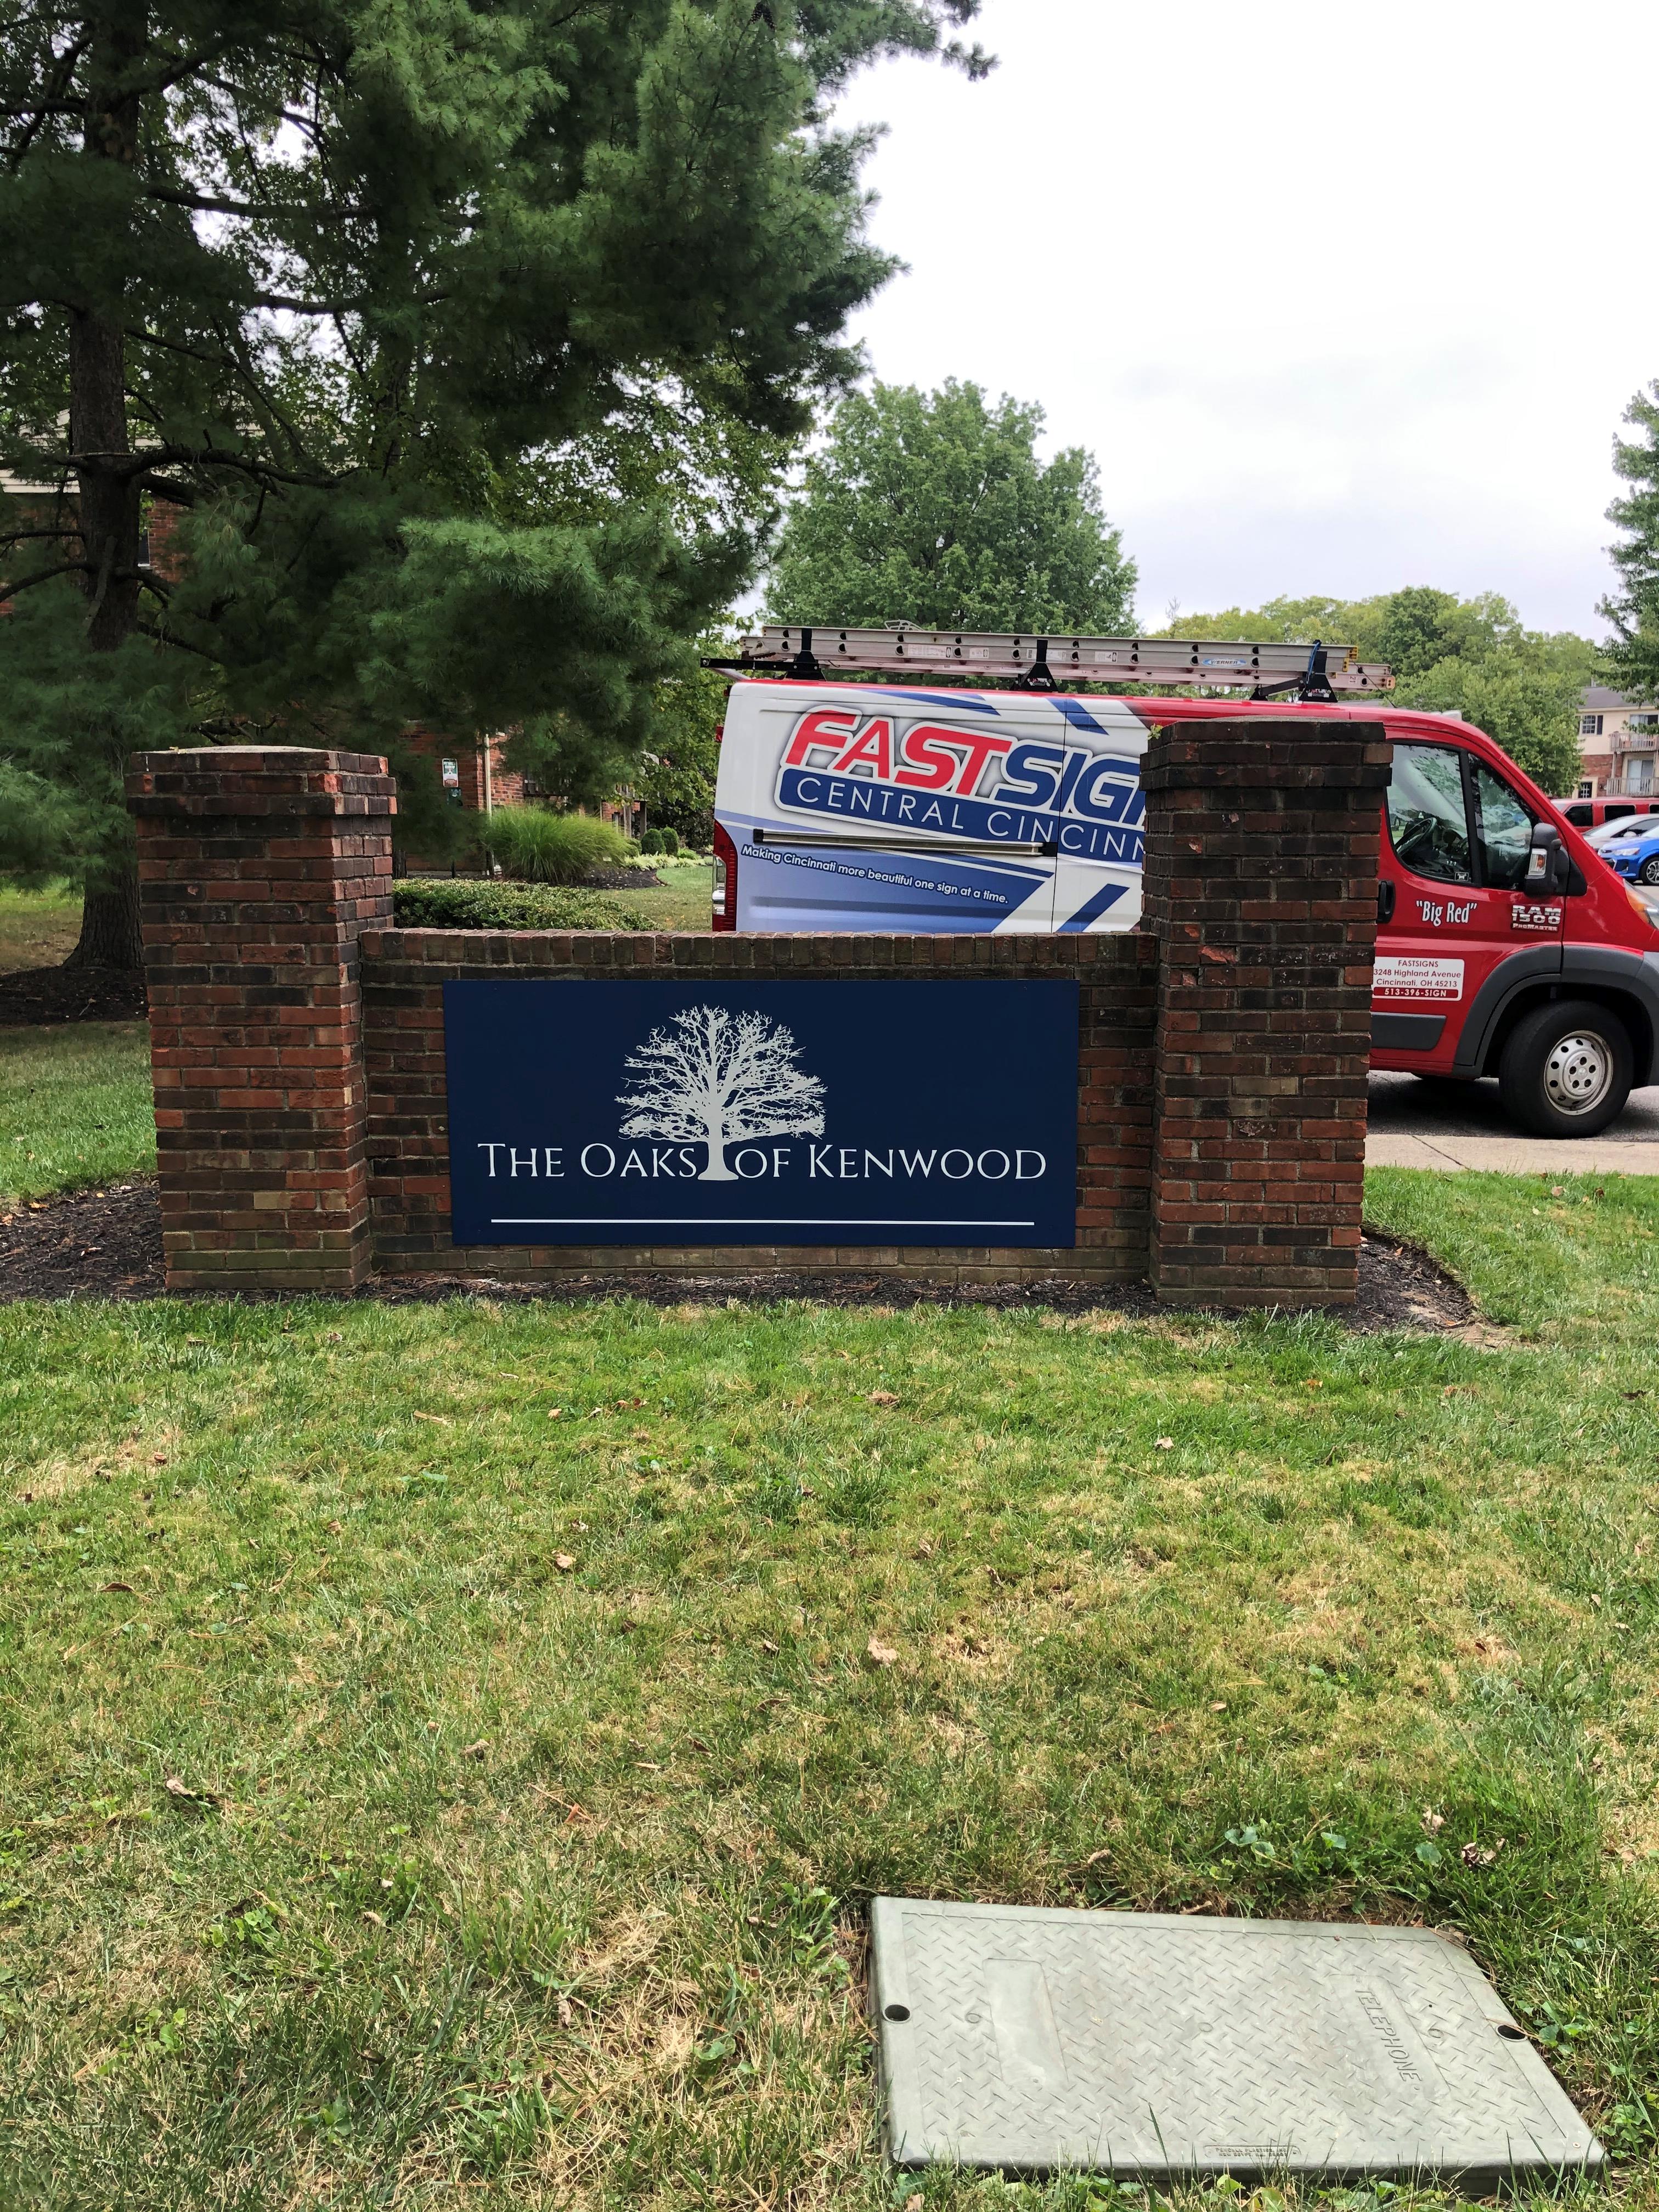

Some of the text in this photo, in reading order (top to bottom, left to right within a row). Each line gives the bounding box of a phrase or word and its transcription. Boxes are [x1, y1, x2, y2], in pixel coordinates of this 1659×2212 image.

[797, 777, 964, 830] CENTRAL
[742, 845, 1008, 904] Making Cincinnati more beautiful one sign at a time.
[1512, 905, 1562, 916] RAM
[1511, 913, 1561, 924] 1500
[1398, 960, 1438, 968] FASTSIGNS
[1394, 969, 1429, 978] Highland
[1376, 978, 1418, 987] Cincinnati,
[1384, 988, 1447, 997] 513-396-SIGN
[477, 1143, 1047, 1180] THE OAKS OF KENWOOD
[1355, 1989, 1423, 2082] TELEPHONE
